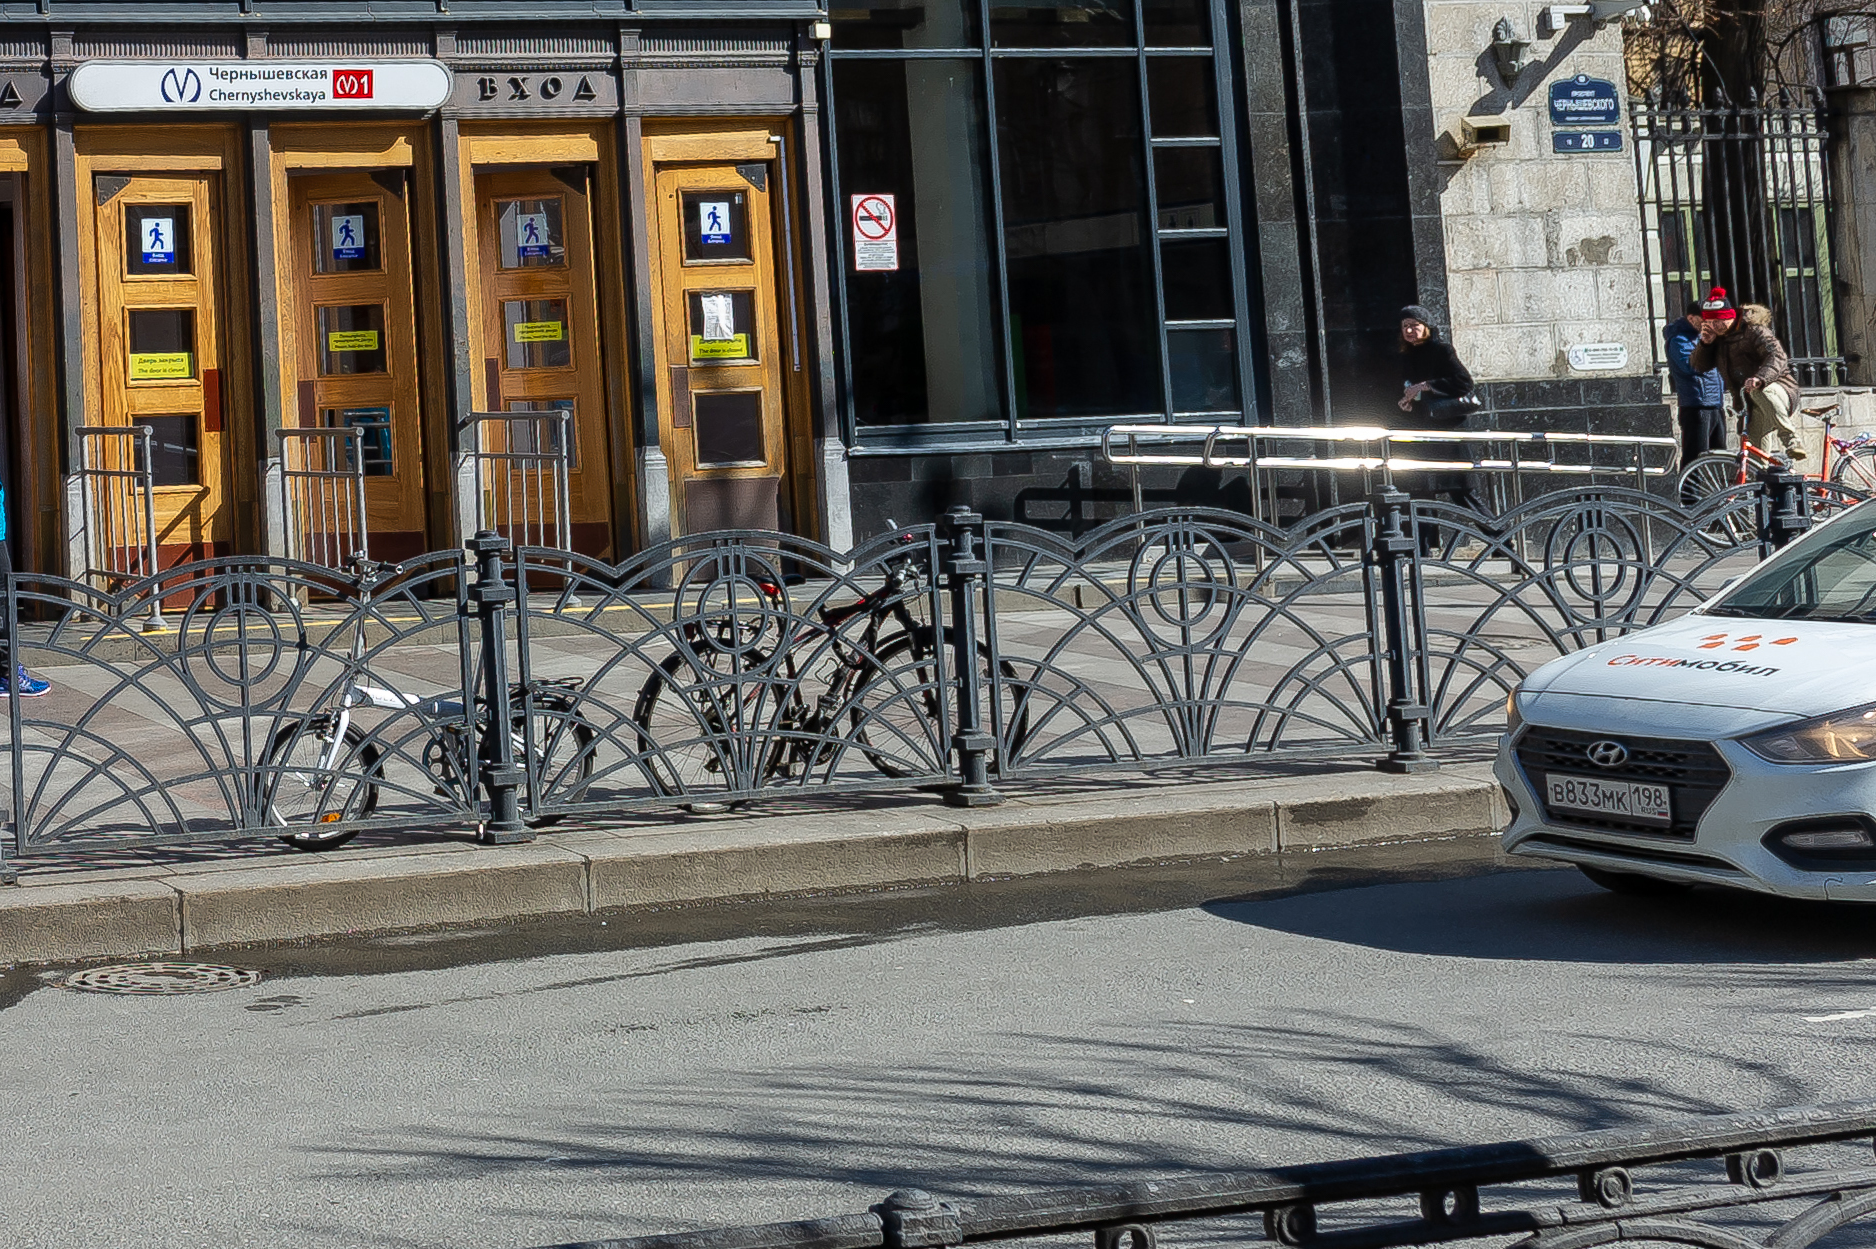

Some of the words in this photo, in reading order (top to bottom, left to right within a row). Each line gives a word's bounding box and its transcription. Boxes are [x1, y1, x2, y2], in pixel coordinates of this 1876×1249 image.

[209, 67, 328, 84] Чернышевская
[209, 88, 326, 104] Chernyshevskaya
[477, 76, 598, 102] ВХОД
[1580, 133, 1595, 149] 20
[1607, 655, 1781, 677] Ситимобил
[1553, 779, 1629, 811] В833МК
[1631, 786, 1663, 807] 198
